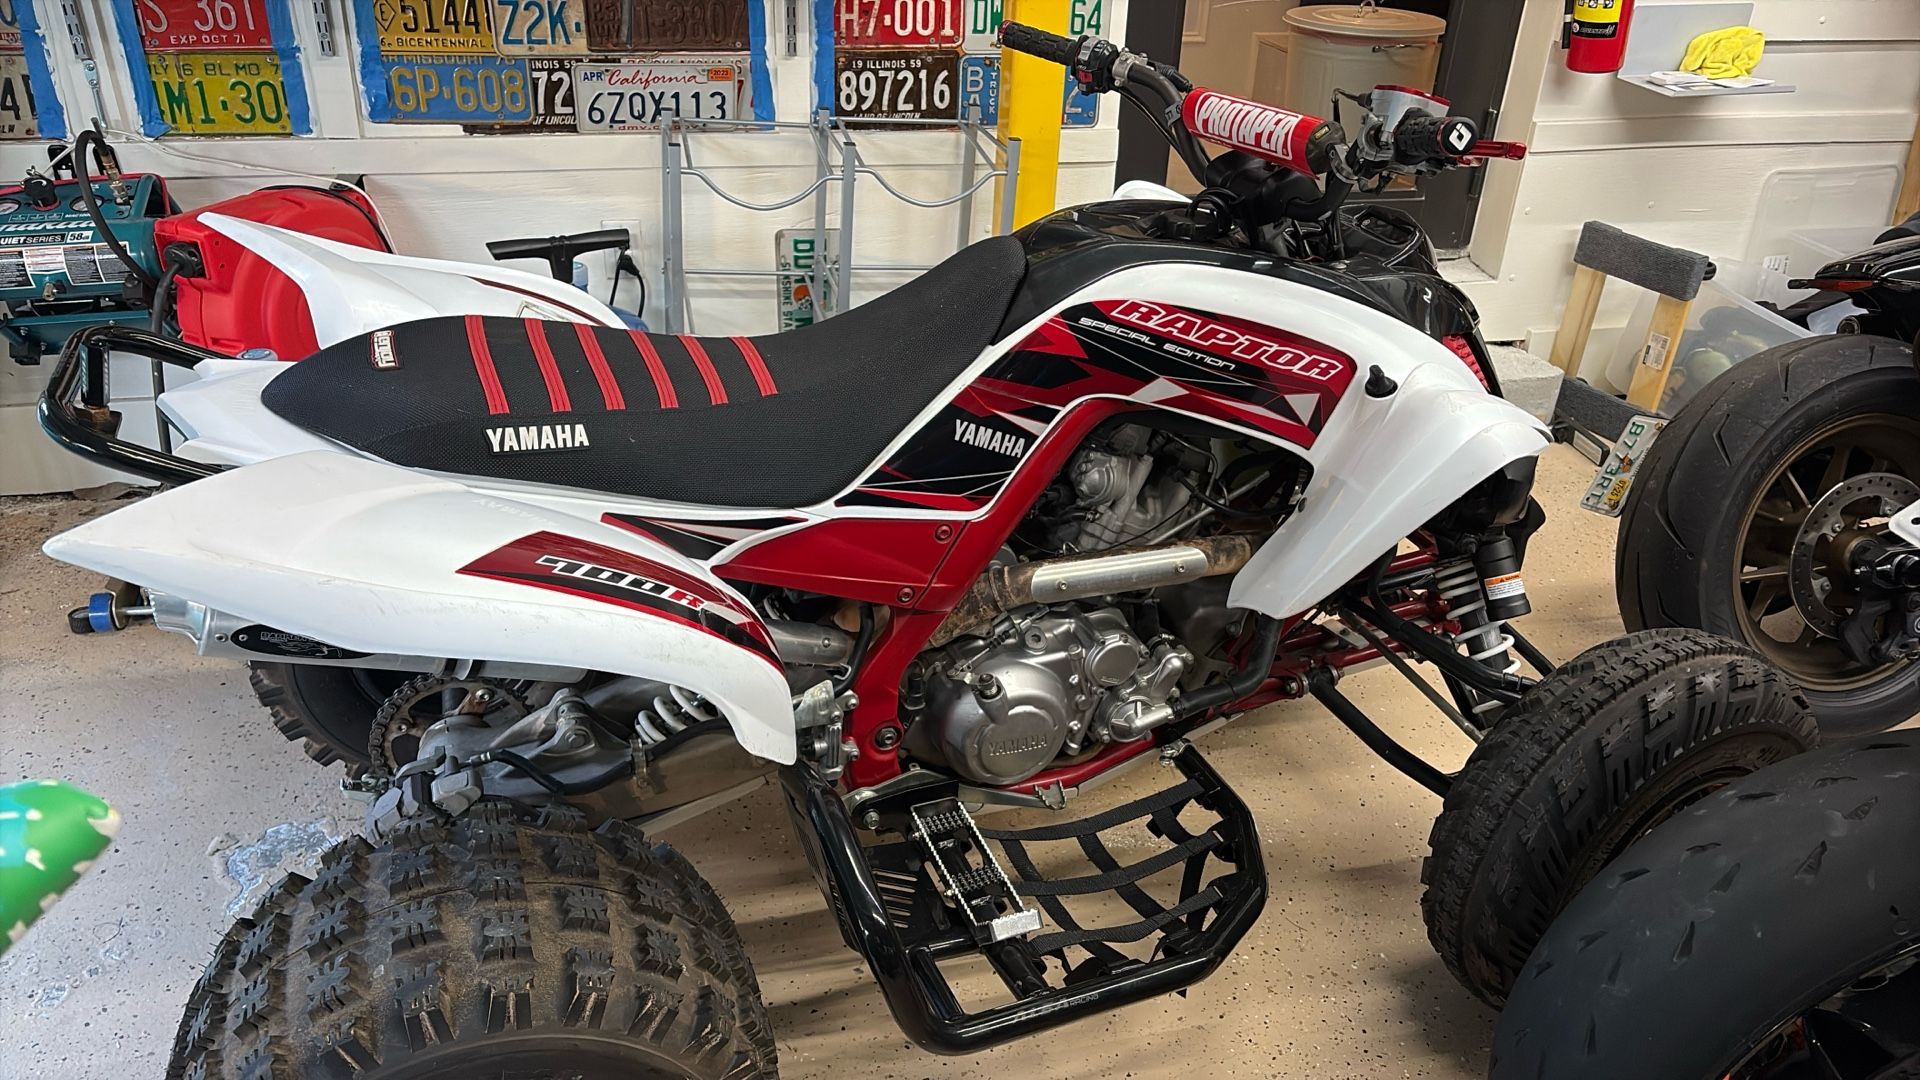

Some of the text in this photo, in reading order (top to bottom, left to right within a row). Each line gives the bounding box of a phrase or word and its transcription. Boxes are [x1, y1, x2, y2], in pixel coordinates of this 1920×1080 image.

[1070, 0, 1101, 35] 64
[170, 34, 246, 44] EXP OCT 71
[397, 37, 486, 48] BICENTENNIAL
[236, 63, 261, 76] MO
[583, 72, 603, 82] APR
[852, 59, 922, 68] 19 ILLINOIS 59
[608, 69, 708, 90] California
[839, 69, 951, 111] 897216
[588, 91, 726, 125] 6ZQX113
[1199, 95, 1292, 158] PROTAPER
[783, 310, 793, 330] STA
[1078, 317, 1236, 371] SPECIAL EDITION
[1110, 299, 1345, 381] RAPTOR
[486, 424, 590, 454] YAMAHA
[954, 419, 1027, 458] YAMAHA
